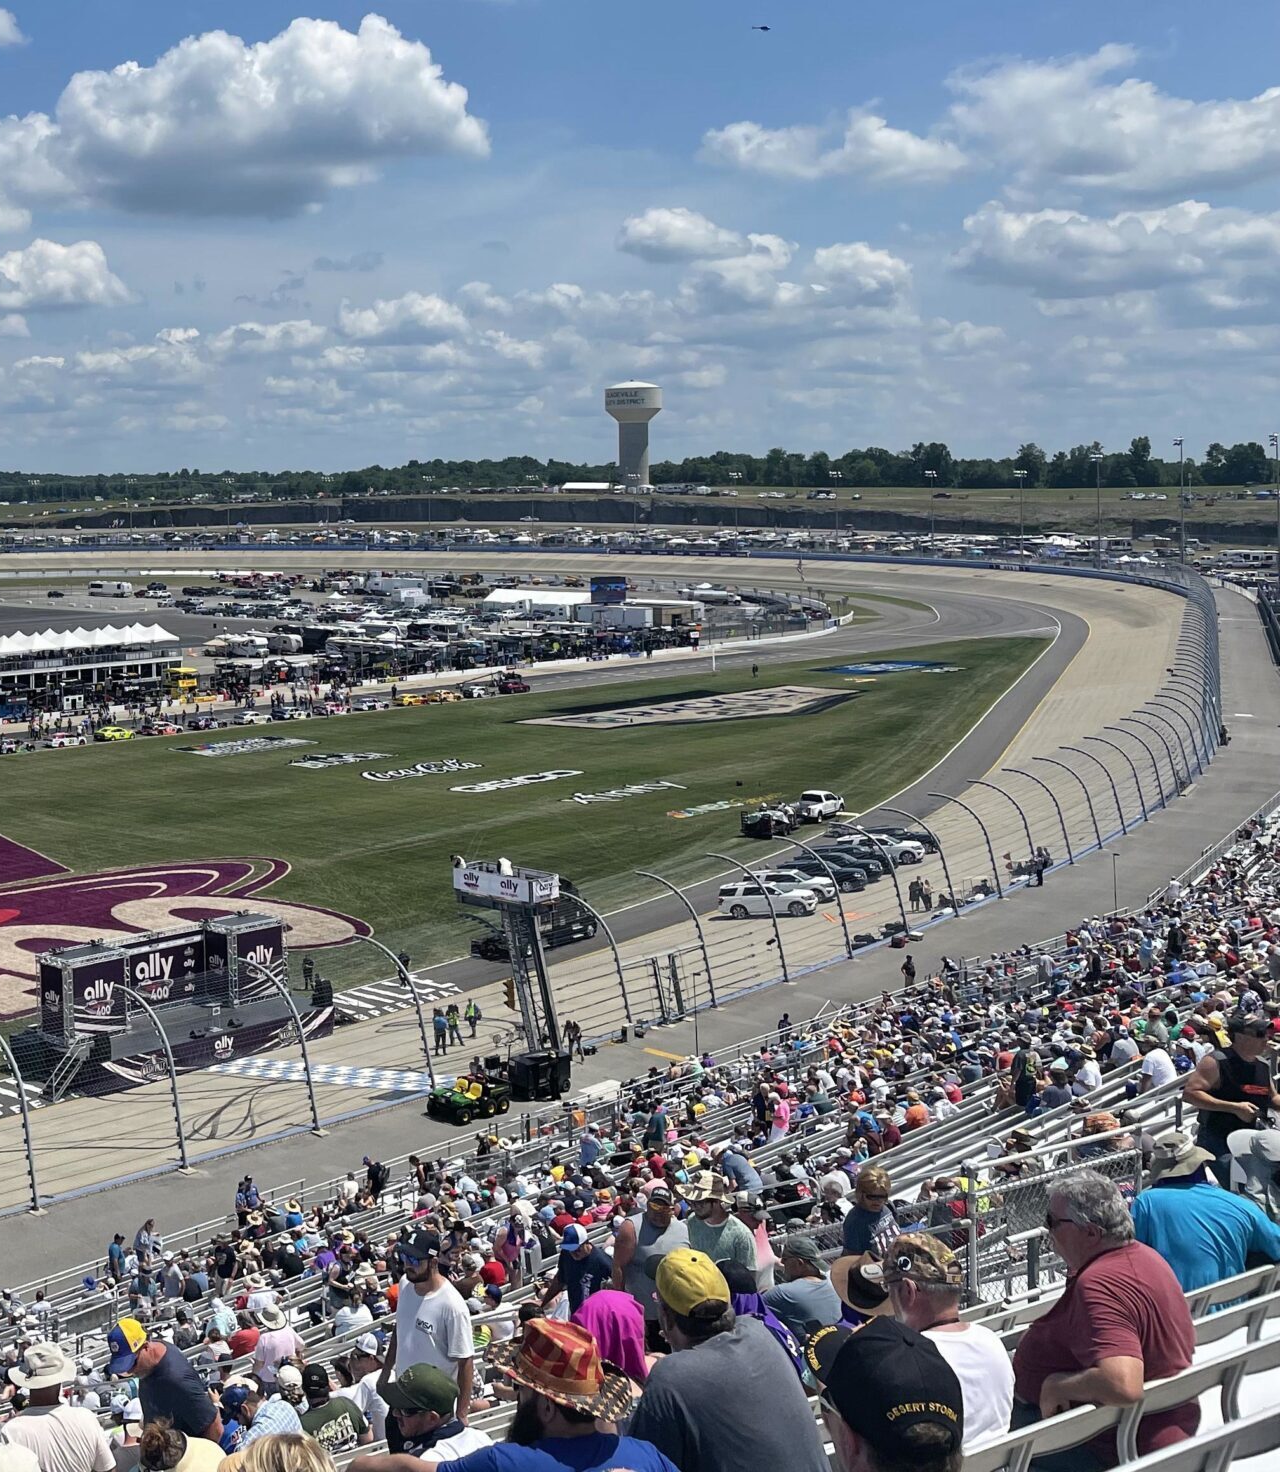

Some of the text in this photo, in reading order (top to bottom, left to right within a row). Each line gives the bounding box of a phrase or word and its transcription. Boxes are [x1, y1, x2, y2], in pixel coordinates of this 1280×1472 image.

[361, 758, 482, 782] Coca-Cola
[448, 769, 584, 793] GEICO
[463, 871, 480, 884] ally
[500, 879, 518, 893] ally
[208, 954, 225, 971] ally
[246, 944, 274, 966] ally
[135, 952, 174, 980] ally
[183, 958, 196, 968] ally
[83, 978, 115, 1001] ally
[150, 985, 170, 1000] 400
[184, 982, 196, 992] ally
[44, 989, 60, 1005] ally
[96, 1005, 112, 1016] 400
[214, 1035, 235, 1050] ally
[416, 1318, 434, 1332] NASA
[886, 1401, 959, 1423] DESERT STORM
